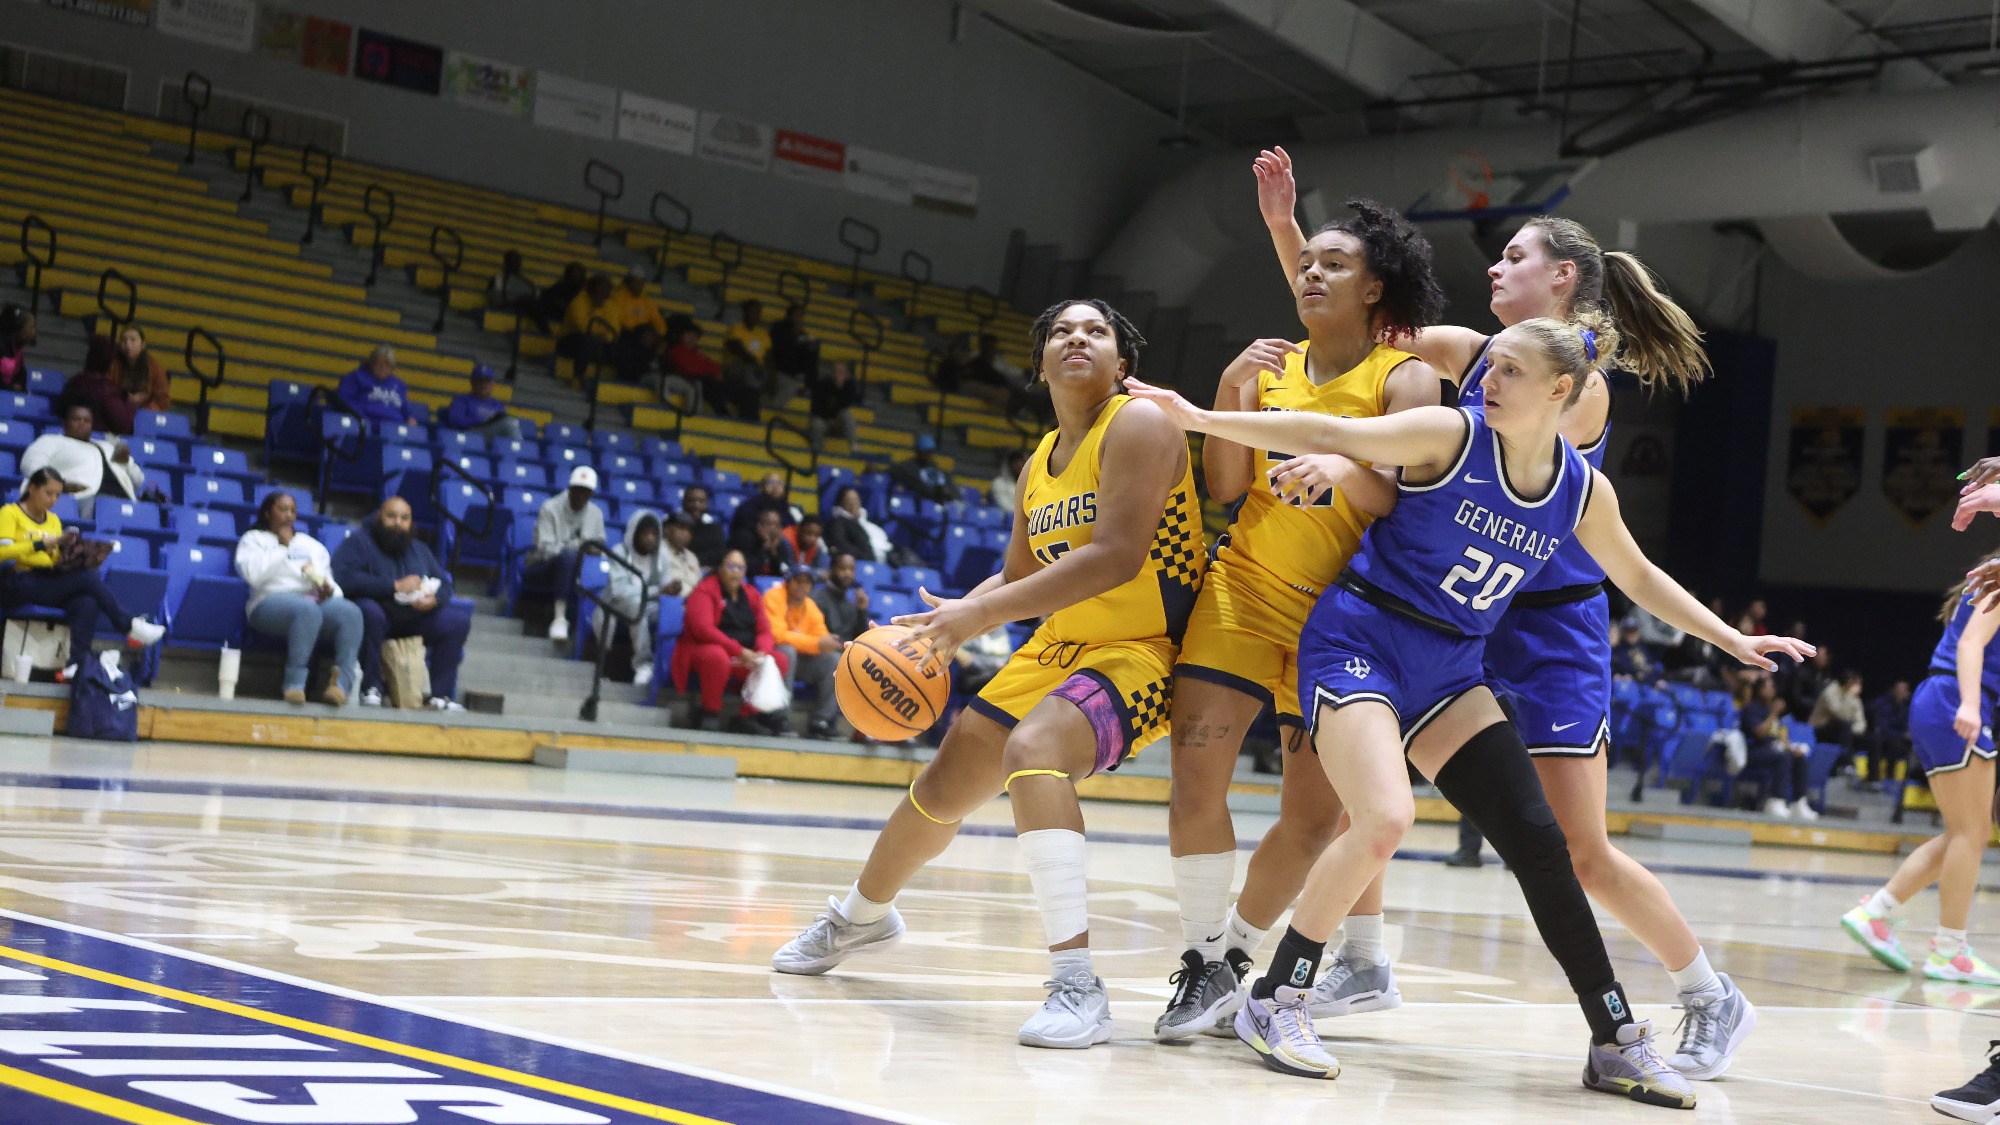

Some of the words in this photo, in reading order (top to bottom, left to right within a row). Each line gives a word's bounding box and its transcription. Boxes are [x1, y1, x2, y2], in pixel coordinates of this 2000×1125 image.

[1028, 491, 1098, 537] UGARS
[1453, 498, 1561, 561] GENERALS
[1438, 544, 1526, 611] 20
[861, 656, 920, 722] Wilson
